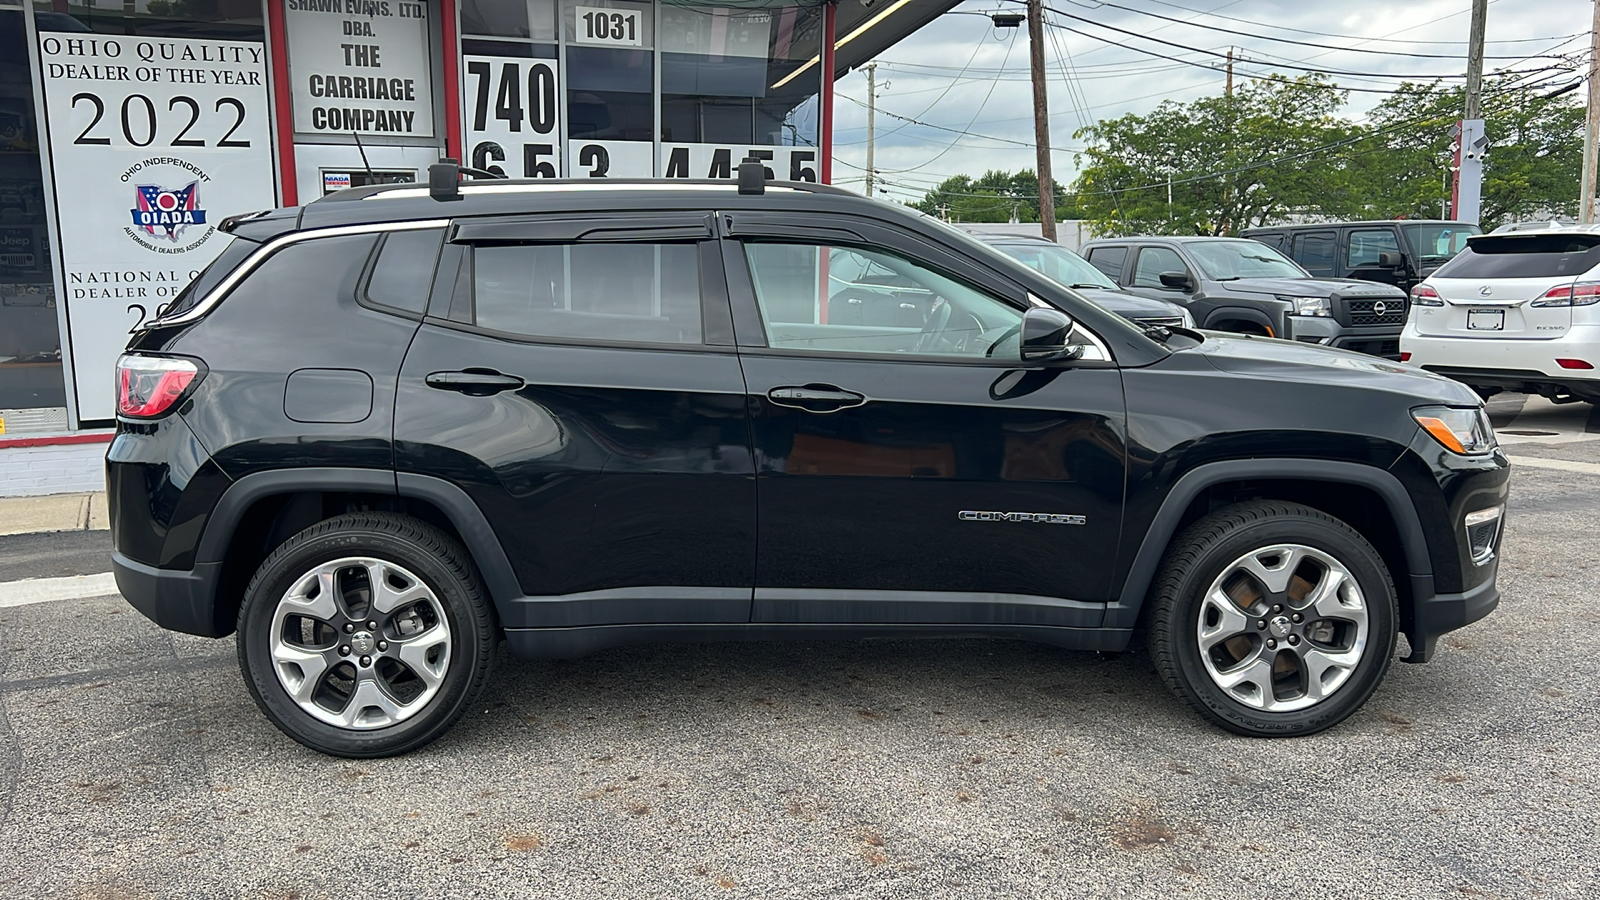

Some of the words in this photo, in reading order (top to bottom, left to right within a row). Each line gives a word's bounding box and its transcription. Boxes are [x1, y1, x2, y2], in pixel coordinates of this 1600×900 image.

[289, 0, 342, 13] SHAWN
[399, 3, 426, 19] LTD.
[342, 20, 376, 37] DBA.
[582, 11, 635, 41] 1031
[43, 37, 121, 58] OHIO
[136, 42, 262, 64] QUALITY
[341, 43, 381, 68] THE
[48, 63, 131, 81] DEALER
[135, 67, 161, 82] OF
[166, 68, 207, 84] THE
[210, 70, 262, 86] YEAR
[309, 74, 415, 101] CARRIAGE
[468, 61, 556, 134] 740
[71, 92, 251, 148] 2022
[312, 107, 415, 133] COMPANY
[120, 163, 142, 183] OHIO
[142, 157, 211, 183] INDEPENDENT
[140, 211, 194, 224] OIADA
[1, 235, 30, 247] Jeep
[123, 226, 157, 253] AUTOMOBILE
[186, 225, 216, 252] ASSOCIATION
[70, 271, 179, 284] NATIONAL
[74, 287, 147, 299] DEALER
[156, 286, 178, 297] OF
[958, 510, 1087, 526] COMPASS
